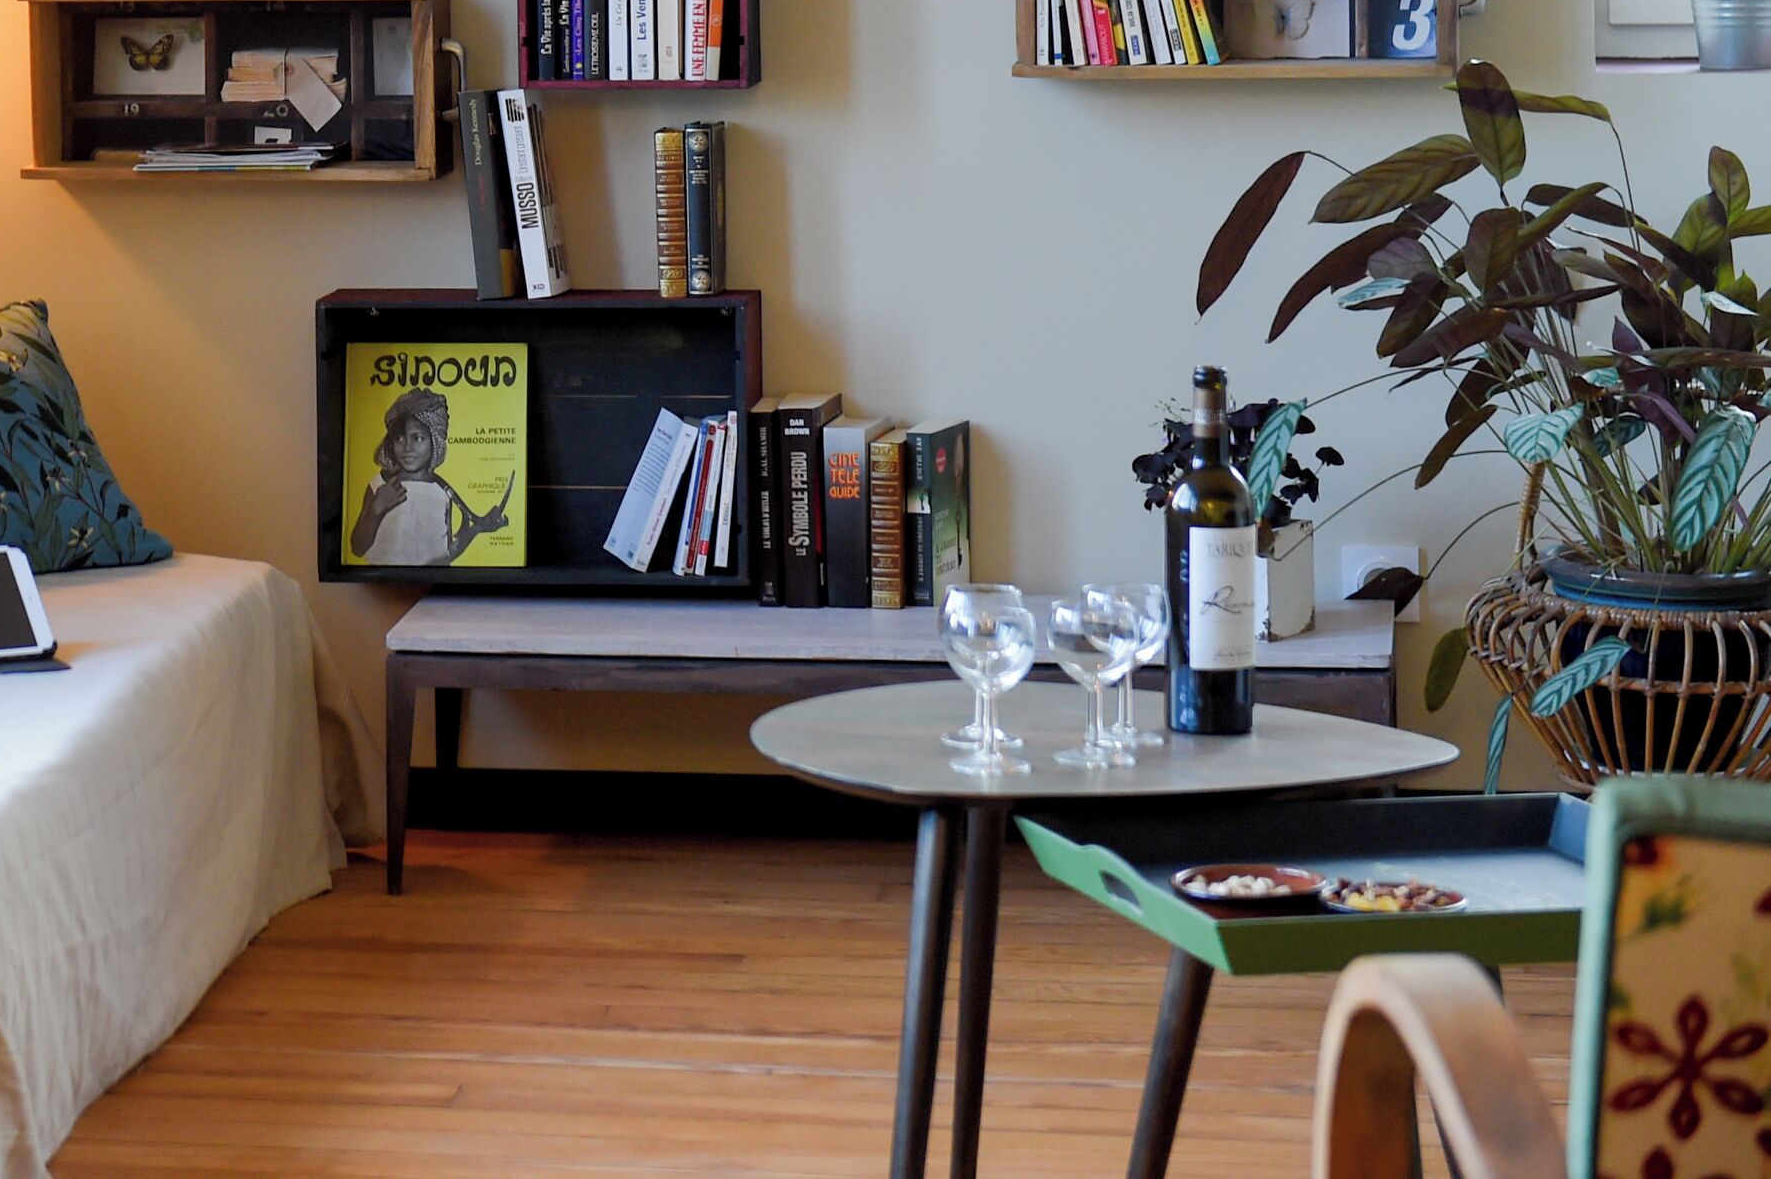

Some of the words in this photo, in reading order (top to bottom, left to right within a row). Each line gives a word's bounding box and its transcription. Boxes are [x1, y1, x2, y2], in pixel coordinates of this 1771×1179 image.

[540, 6, 553, 26] après
[691, 3, 706, 17] EN
[636, 22, 647, 41] Les
[691, 19, 706, 55] FEMME
[691, 56, 707, 78] UNE
[468, 98, 480, 132] Kennedy
[471, 133, 483, 166] Douglas
[515, 181, 540, 230] MUSSO
[475, 427, 486, 435] LA
[488, 427, 517, 435] PETITE
[784, 426, 810, 436] BROWN
[788, 418, 805, 427] DAN
[447, 436, 518, 446] CAMBODGIENNE
[790, 451, 807, 489] PERDU
[828, 485, 860, 499] GUIDE
[787, 489, 811, 547] SYMBOLE
[795, 545, 807, 556] LE
